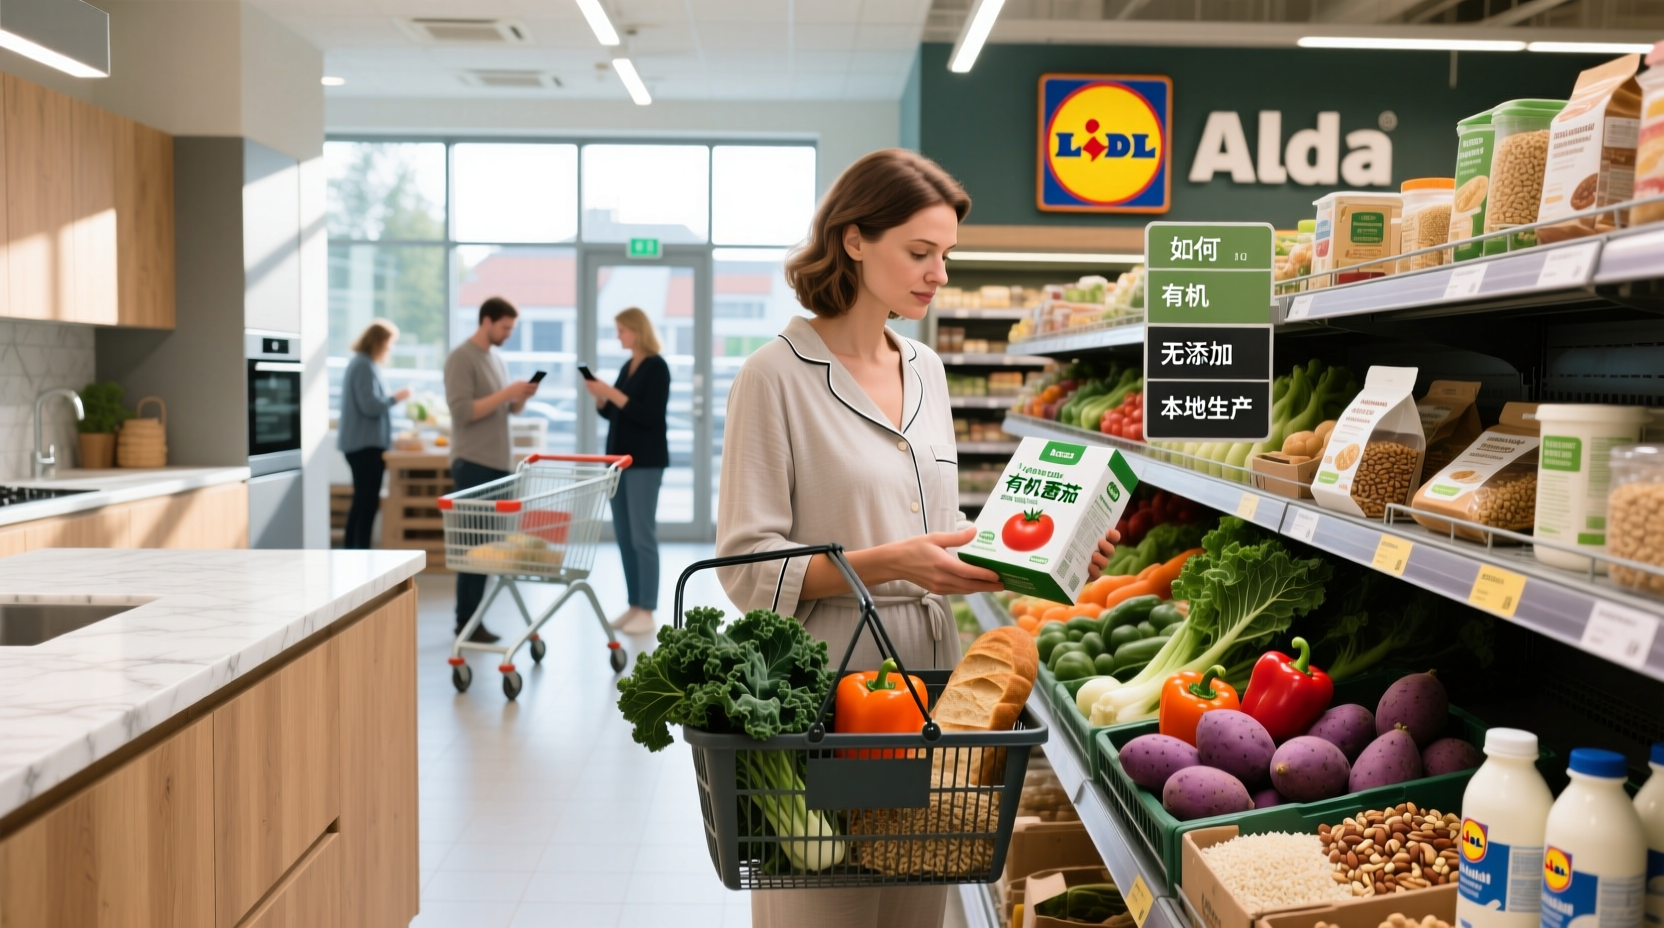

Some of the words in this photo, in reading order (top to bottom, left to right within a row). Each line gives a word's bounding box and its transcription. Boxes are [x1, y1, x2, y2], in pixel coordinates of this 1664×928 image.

[1170, 236, 1221, 261] 如何
[1161, 283, 1209, 307] 有机
[1161, 341, 1233, 366] 无添加
[1161, 395, 1253, 420] 本地生产
